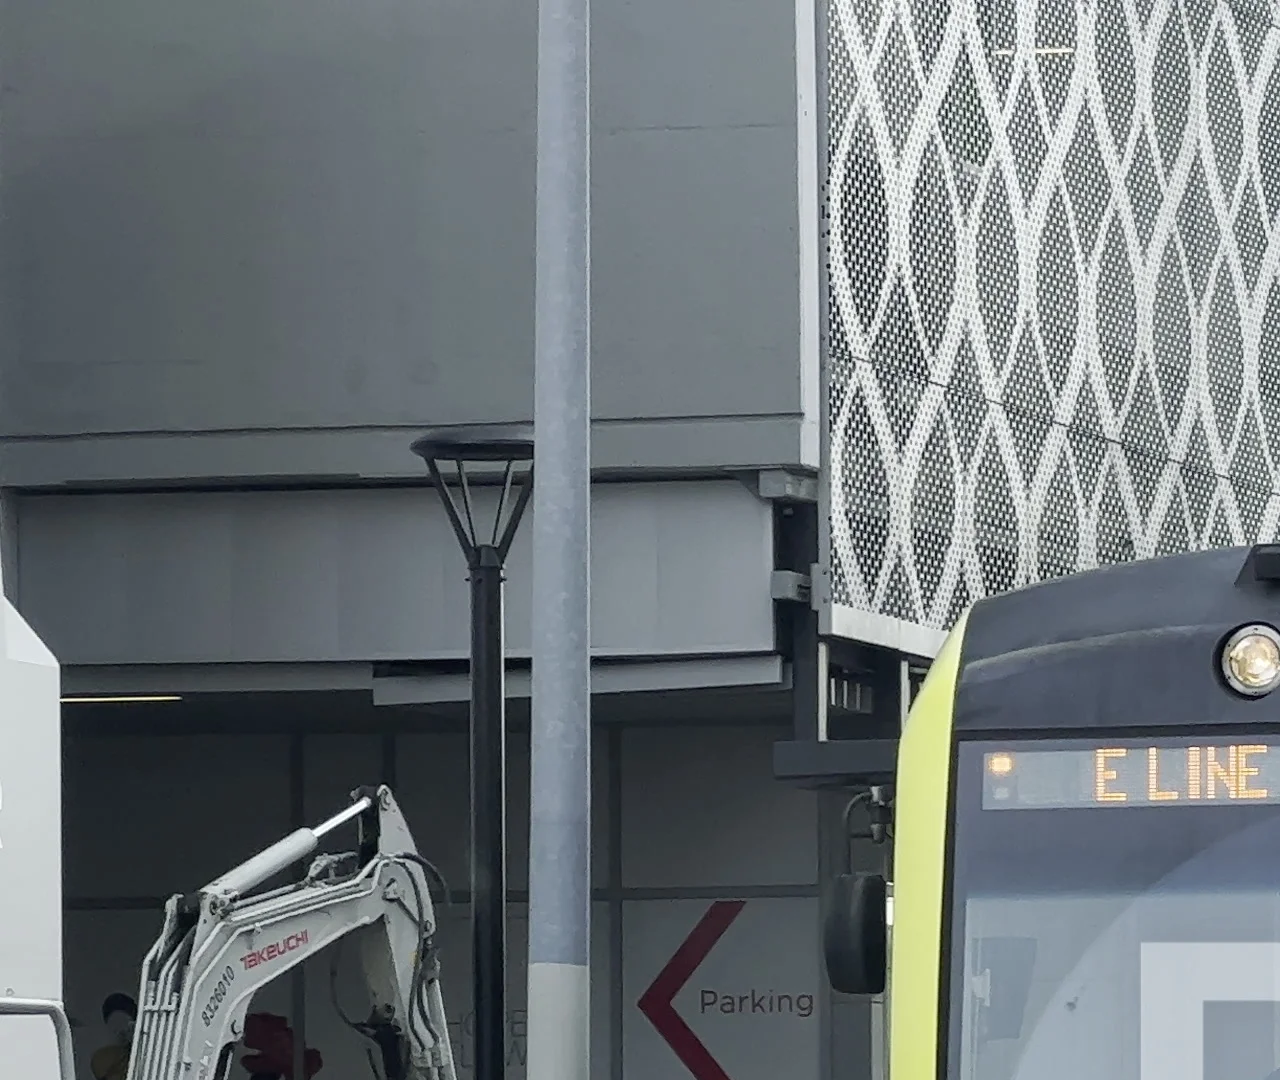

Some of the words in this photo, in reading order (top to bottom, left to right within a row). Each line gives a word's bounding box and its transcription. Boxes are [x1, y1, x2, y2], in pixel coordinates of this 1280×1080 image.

[1095, 748, 1127, 801] E
[1148, 744, 1268, 801] LINE
[240, 929, 309, 970] TAKEUCHI
[201, 965, 235, 1027] 8326010
[700, 989, 814, 1018] Parking
